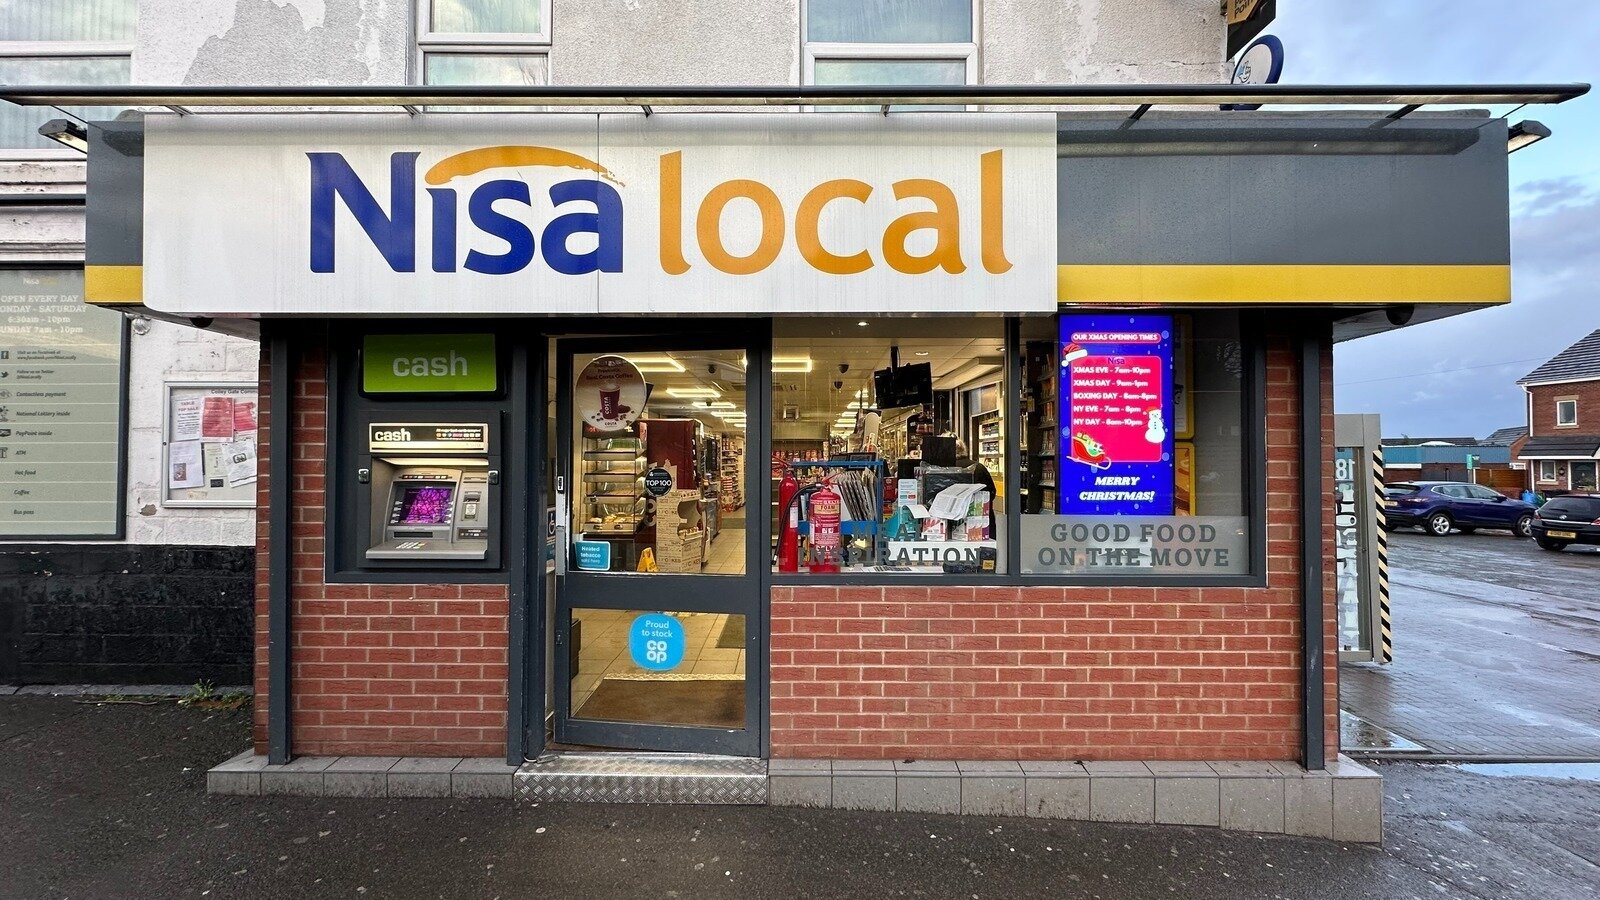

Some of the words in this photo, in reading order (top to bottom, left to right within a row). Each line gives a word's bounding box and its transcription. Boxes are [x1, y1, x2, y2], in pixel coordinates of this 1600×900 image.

[307, 150, 624, 274] Nisa
[659, 148, 1014, 275] local
[60, 294, 79, 302] DAY
[48, 316, 70, 324] 10pm
[392, 350, 468, 377] cash
[375, 428, 411, 442] cash
[1094, 476, 1140, 485] MERRY
[1079, 491, 1155, 501] CHRISTMAS!
[1050, 523, 1130, 542] GOOD
[1140, 524, 1216, 543] FOOD
[1038, 548, 1076, 566] ON
[1086, 548, 1140, 566] THE
[1150, 548, 1229, 567] MOVE
[646, 620, 669, 628] Proud
